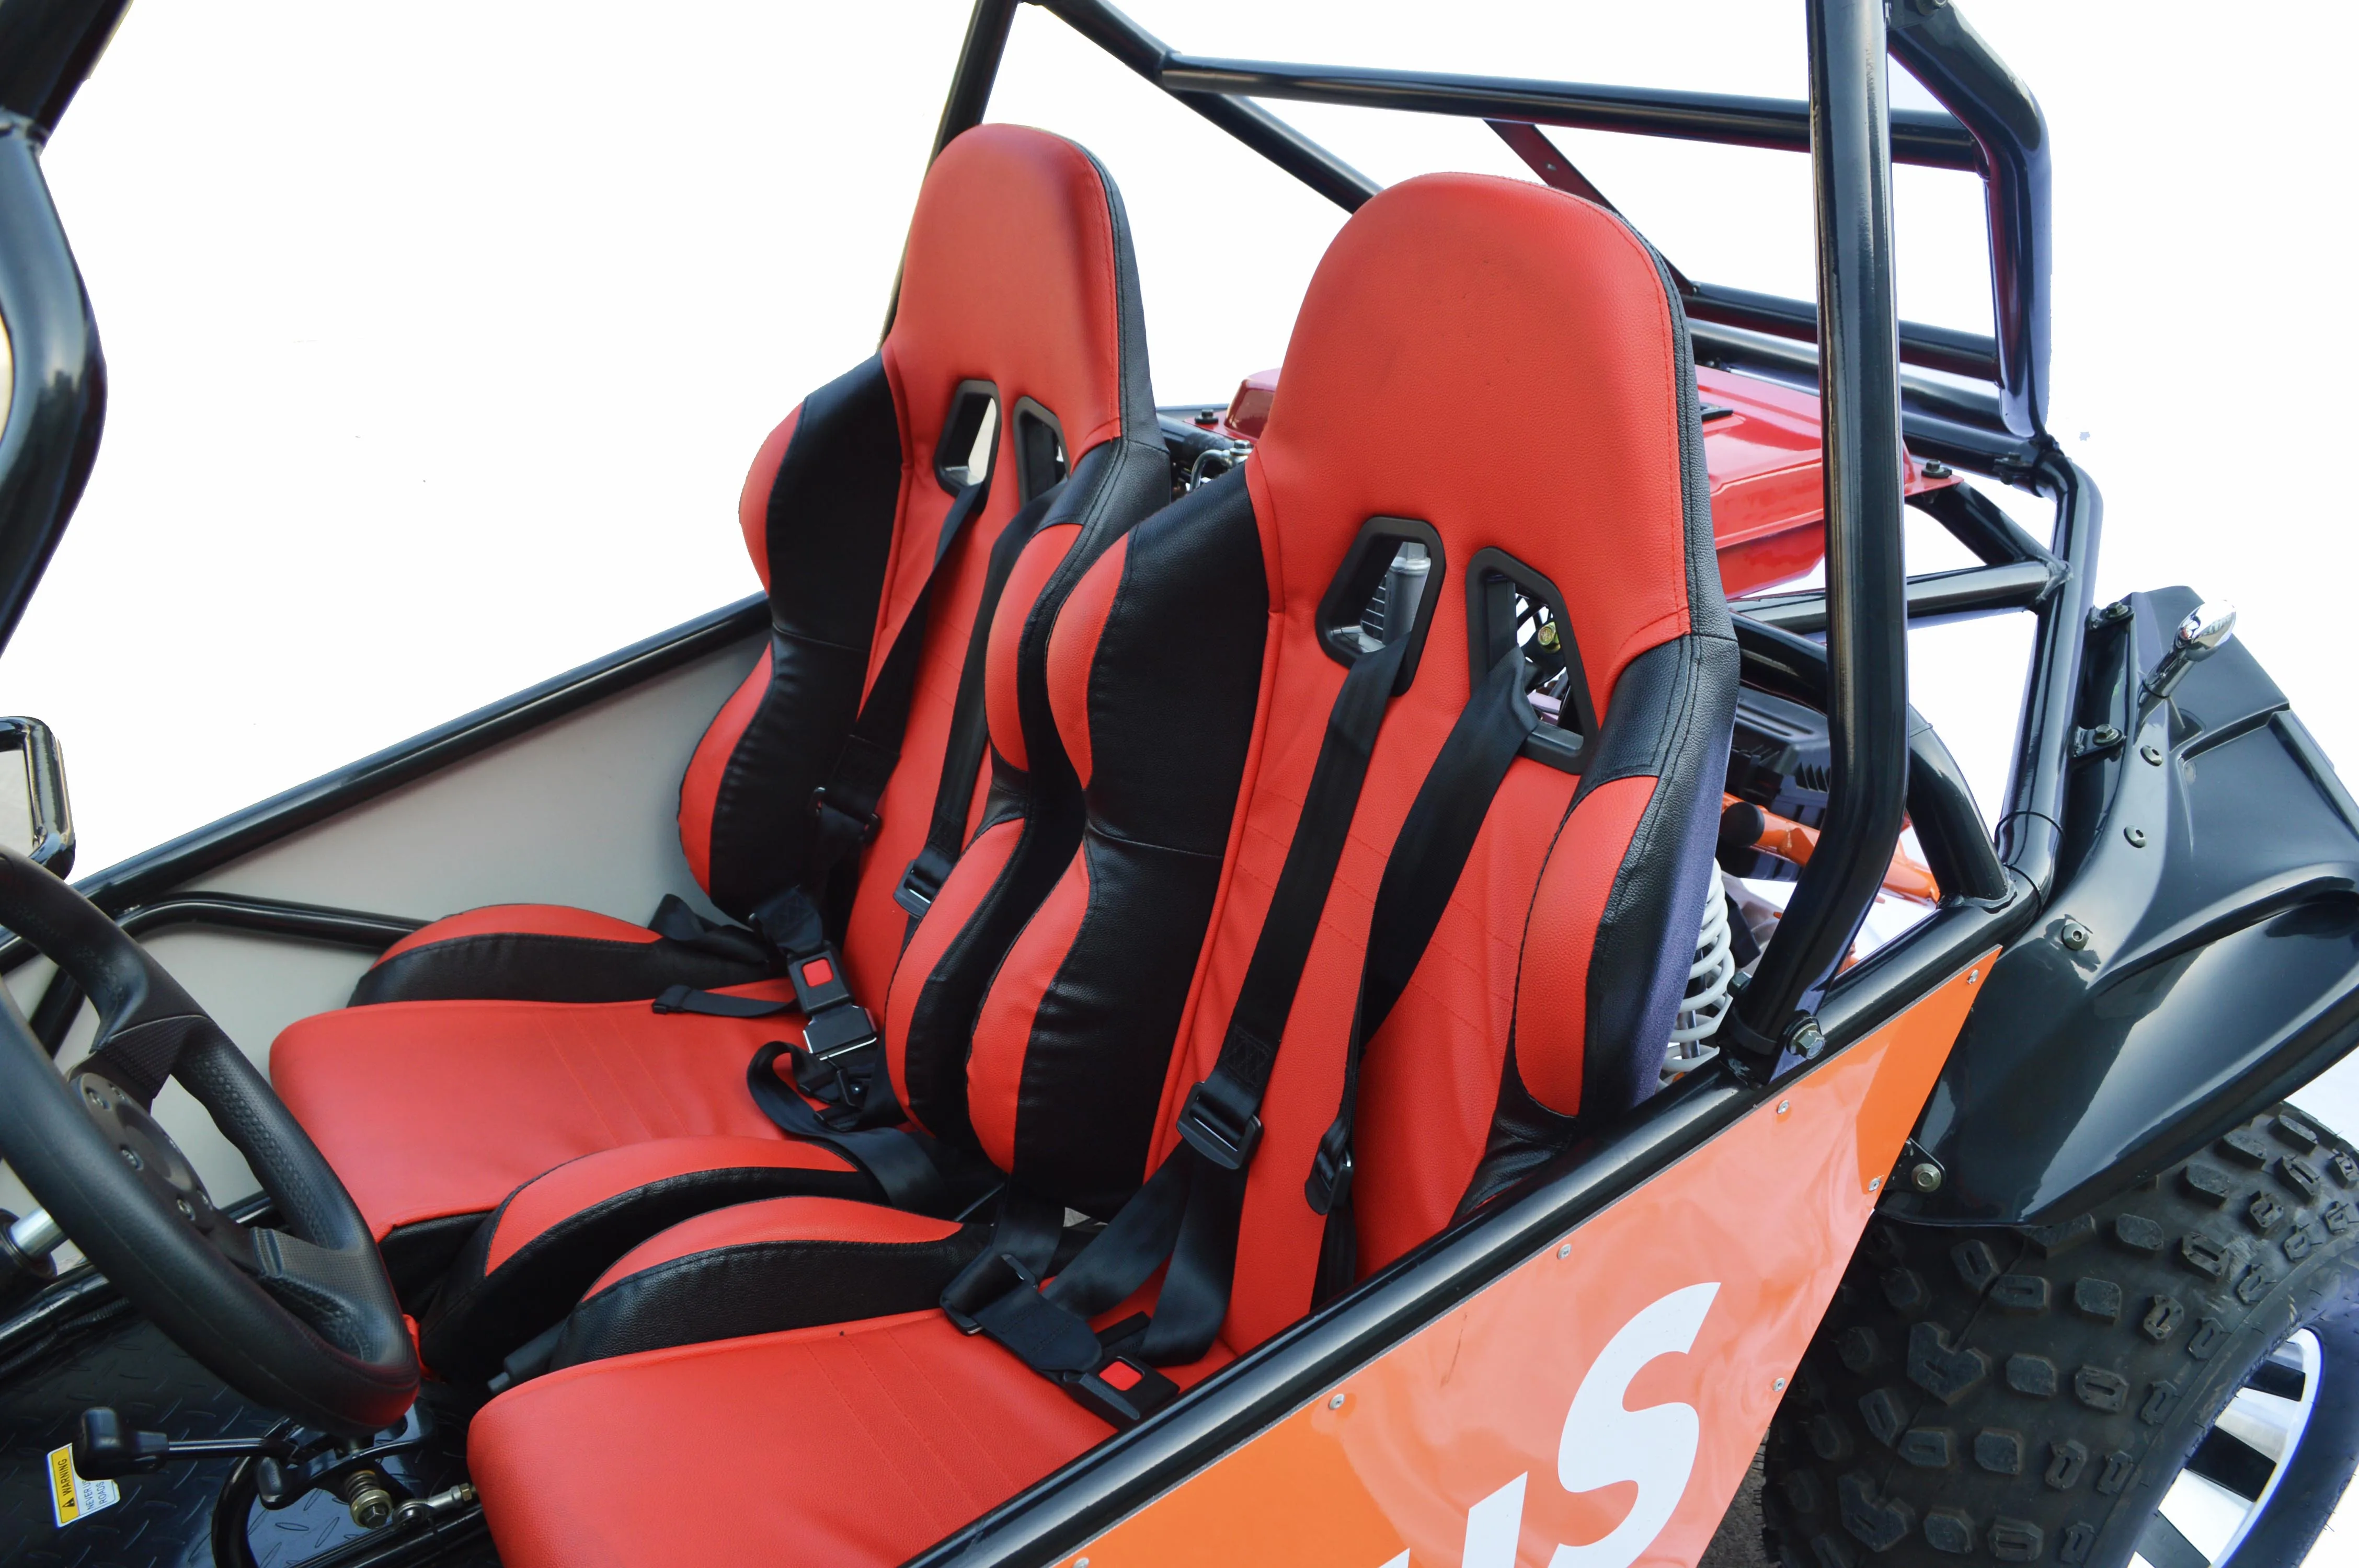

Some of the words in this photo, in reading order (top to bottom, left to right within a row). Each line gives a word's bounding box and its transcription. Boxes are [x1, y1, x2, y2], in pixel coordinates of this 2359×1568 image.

[58, 1458, 72, 1496] WARNING
[84, 1487, 94, 1510] NEVER
[96, 1481, 107, 1504] ROADS
